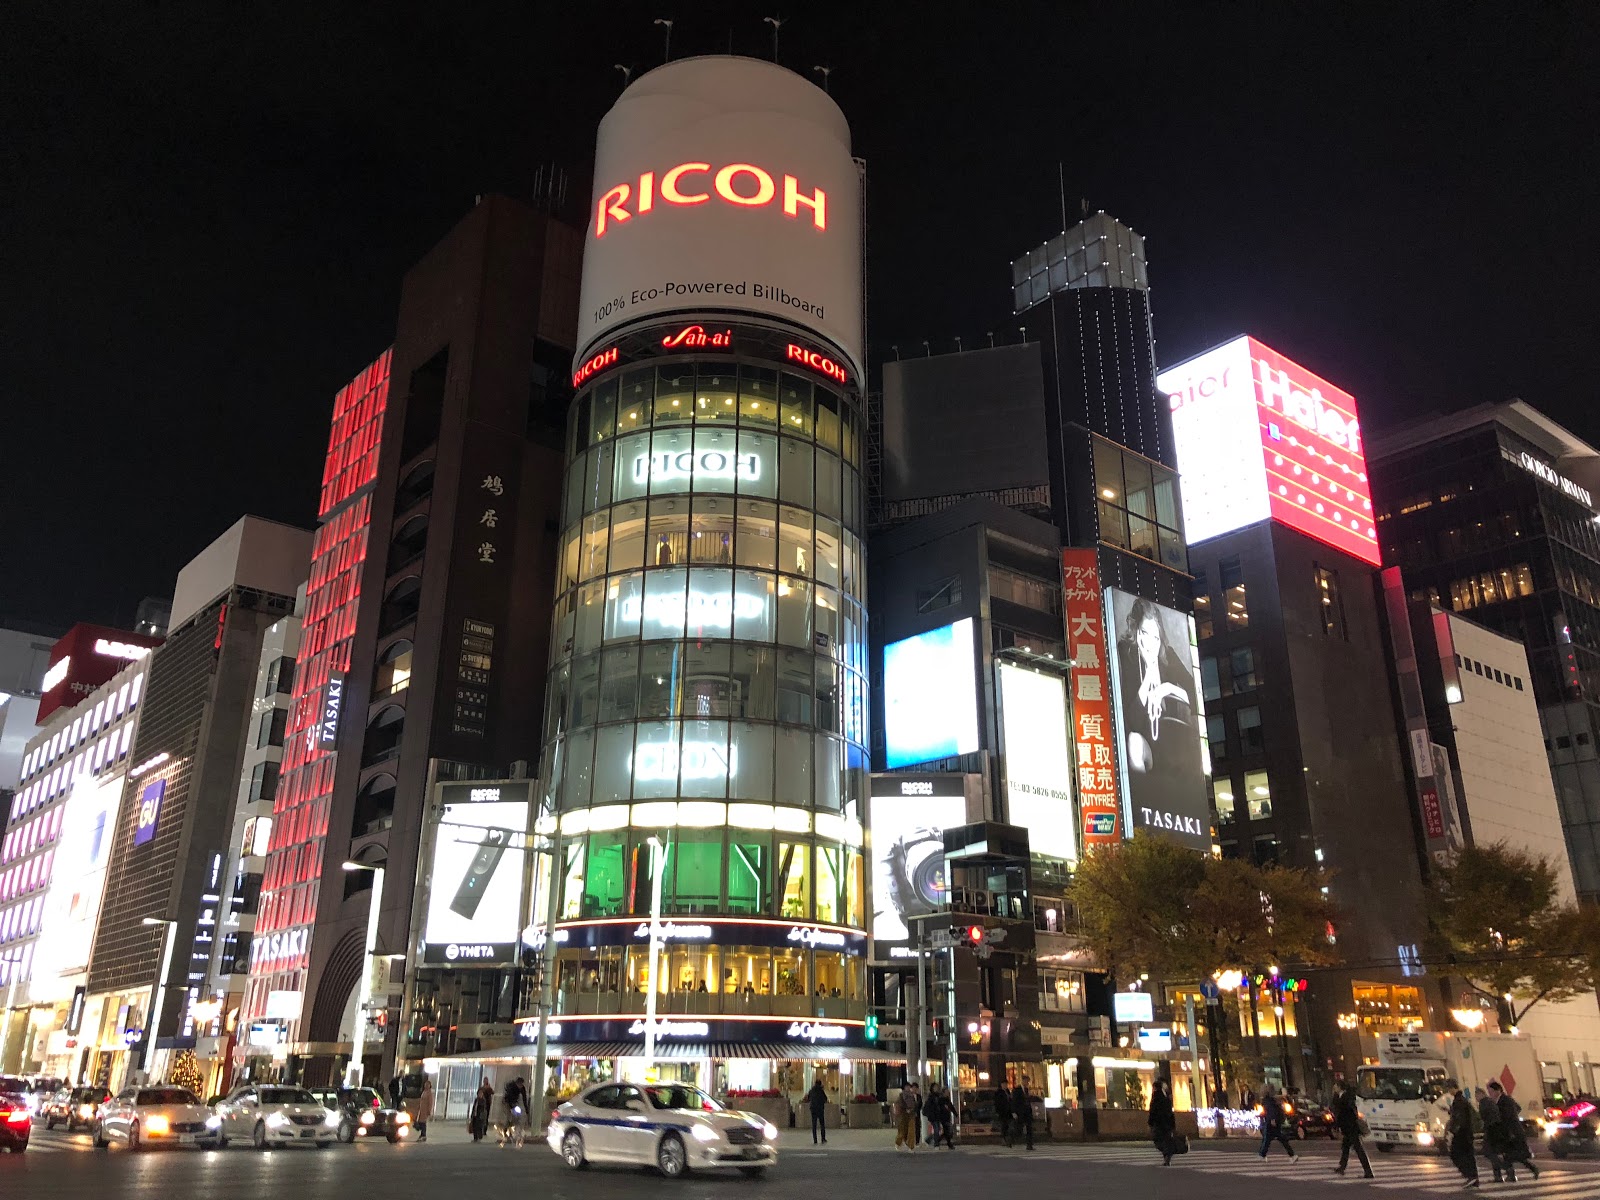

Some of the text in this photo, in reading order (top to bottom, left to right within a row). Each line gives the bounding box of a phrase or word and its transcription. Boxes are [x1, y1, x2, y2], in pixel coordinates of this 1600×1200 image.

[596, 161, 827, 239] RICOH
[593, 281, 825, 324] 100% Eco-Powered Billboard
[662, 325, 732, 348] San-ai
[573, 347, 619, 388] RICOH
[788, 343, 847, 383] RICOH
[1259, 358, 1361, 453] Haier
[634, 451, 760, 481] RICOH
[1521, 451, 1592, 507] GIORGIO ARMANI
[478, 474, 504, 564] 鳩居堂
[1064, 565, 1096, 579] ブランド
[1076, 579, 1086, 589] &
[1066, 588, 1098, 601] チケット
[1071, 612, 1103, 701] 大黒屋
[322, 678, 342, 742] TASAKI
[1079, 714, 1105, 741] 質
[1077, 743, 1112, 766] 買取
[1080, 768, 1114, 791] 販売
[139, 796, 161, 830] GU
[1141, 806, 1202, 836] TASAKI
[251, 928, 309, 963] TASAKI
[458, 945, 495, 958] THETA
